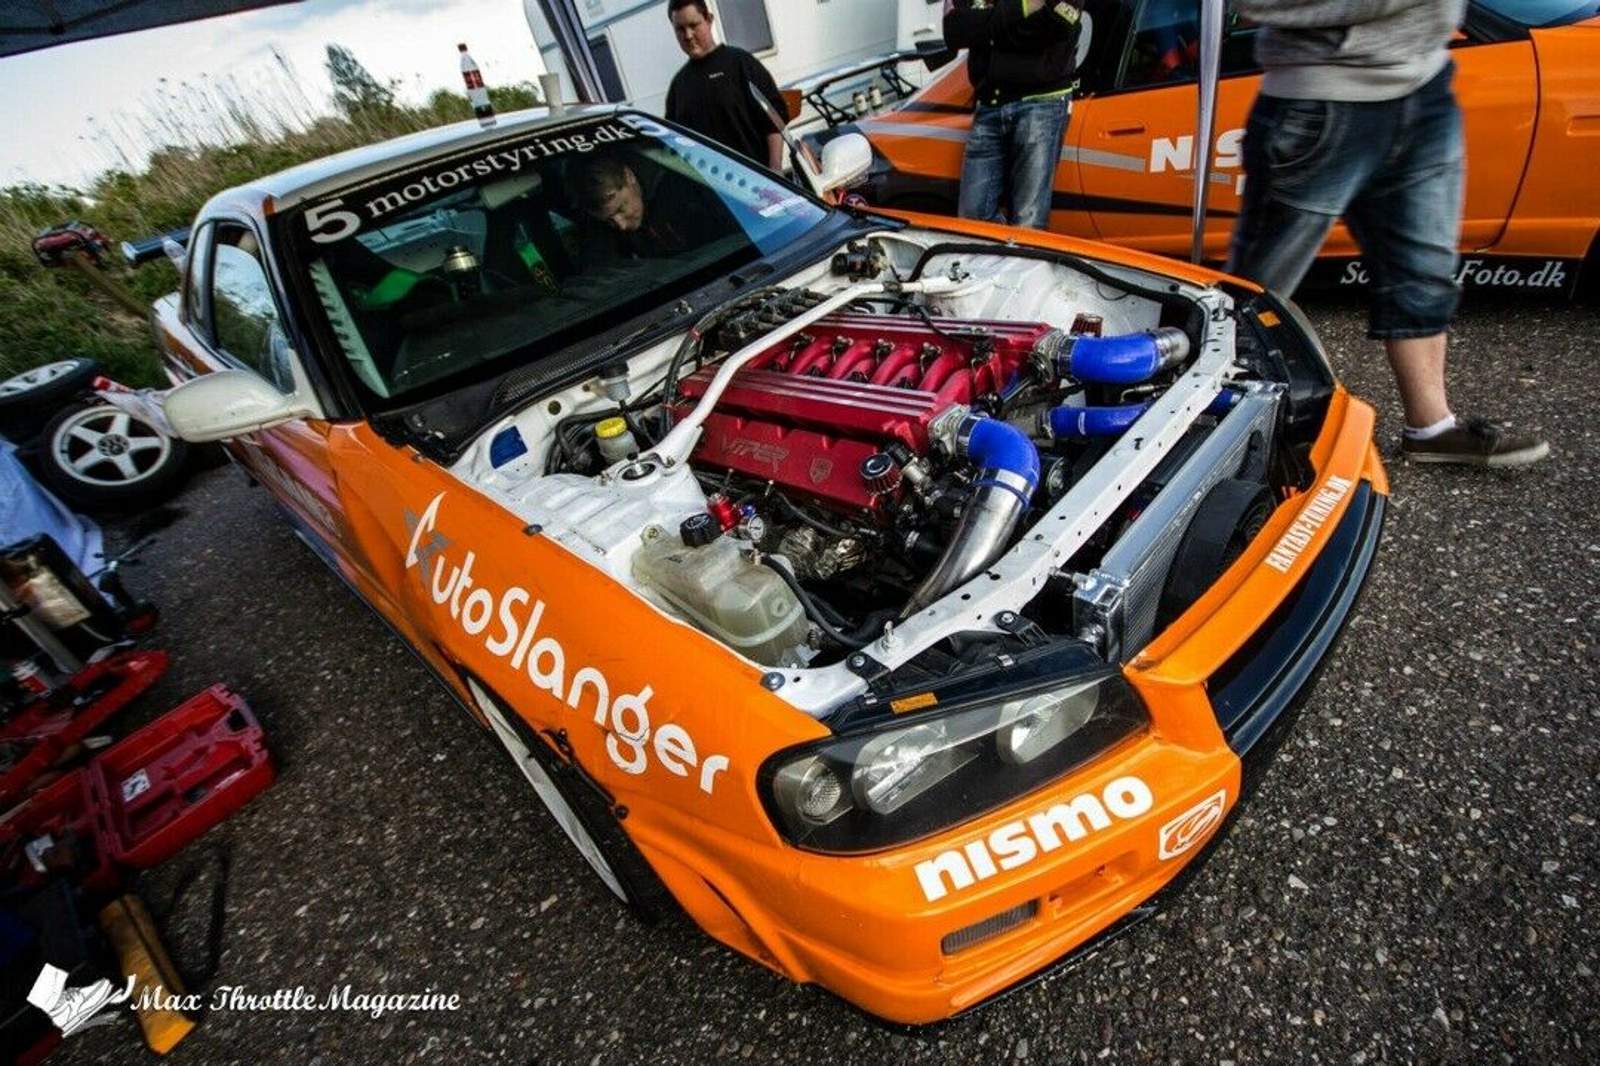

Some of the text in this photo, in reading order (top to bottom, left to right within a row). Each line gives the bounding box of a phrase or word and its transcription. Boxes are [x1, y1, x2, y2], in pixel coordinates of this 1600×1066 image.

[304, 199, 361, 244] 5
[364, 124, 635, 218] motorstyring.dk
[914, 776, 1153, 902] nismo
